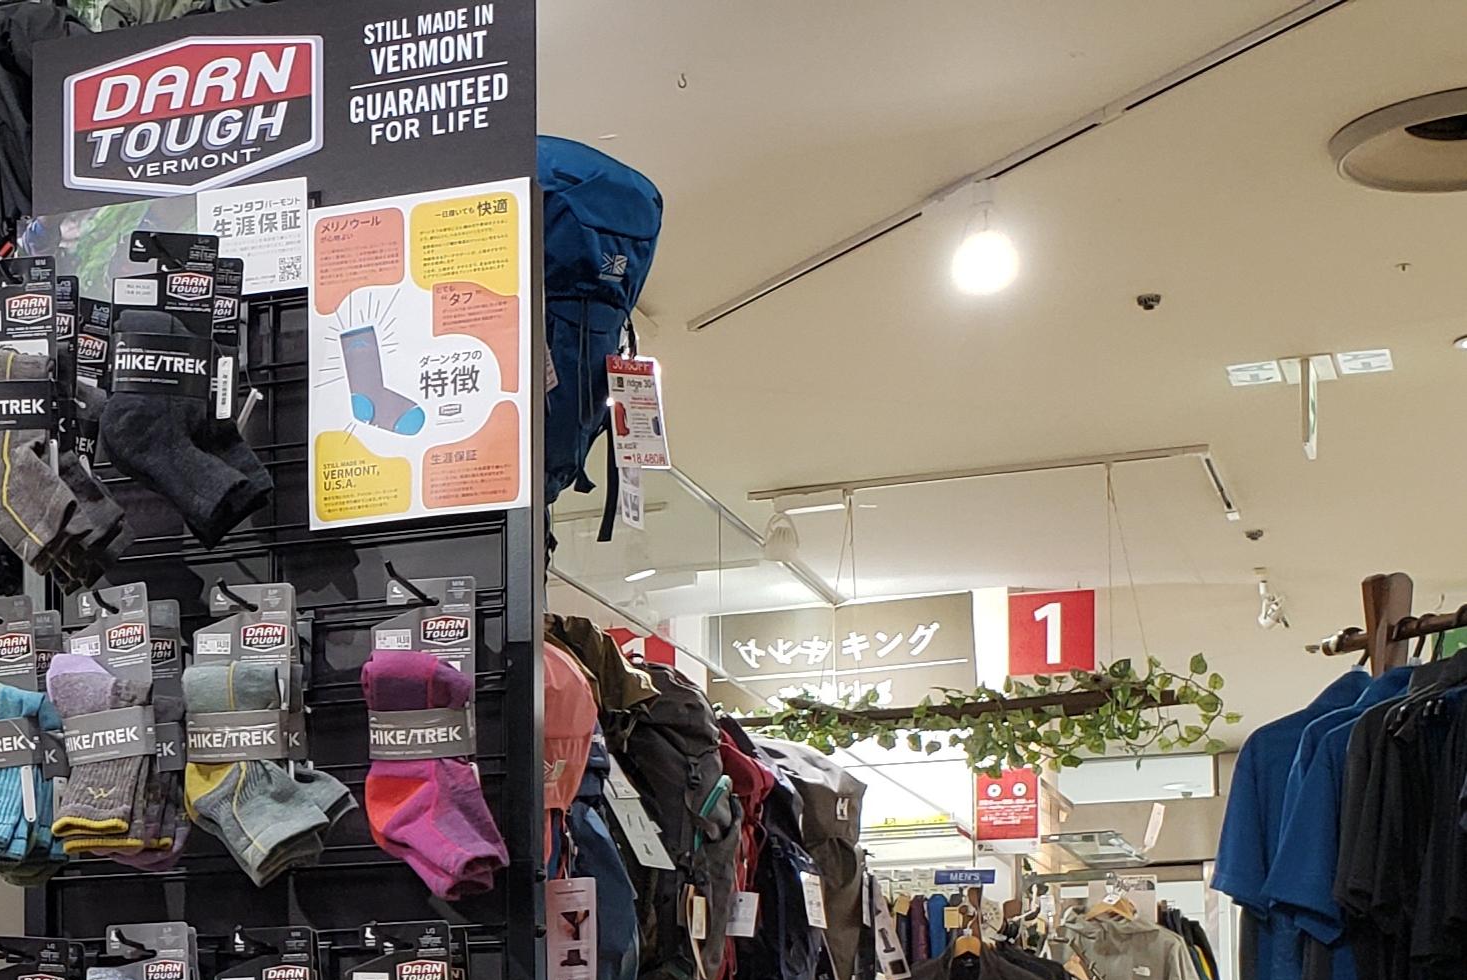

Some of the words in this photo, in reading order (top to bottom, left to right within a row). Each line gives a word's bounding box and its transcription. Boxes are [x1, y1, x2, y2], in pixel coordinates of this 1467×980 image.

[363, 20, 412, 45] STILL
[416, 10, 468, 35] MADE
[474, 4, 495, 26] IN
[370, 31, 487, 76] VERMONT
[92, 46, 298, 123] DARN
[349, 72, 509, 124] GUARANTEED
[87, 100, 289, 167] TOUGH
[370, 120, 420, 145] FOR
[431, 106, 490, 136] LIFE
[126, 147, 257, 179] VERMONT
[477, 198, 509, 217] 快適
[213, 208, 302, 239] 生涯保証
[320, 215, 382, 235] メリノウール
[170, 284, 208, 296] TOUGH
[171, 276, 210, 288] DARN
[9, 297, 50, 310] DARN
[9, 306, 47, 318] TOUGH
[114, 353, 208, 377] HIKE/TREK
[419, 350, 483, 368] ダーンタフの
[419, 364, 481, 400] 特徴
[430, 449, 478, 466] 生涯保証
[323, 464, 380, 481] VERMONT,
[323, 478, 357, 492] U.S.A.
[111, 625, 142, 639] DARN
[246, 626, 284, 637] DARN
[425, 618, 466, 632] DARN
[1033, 602, 1063, 665] 1
[110, 634, 142, 646] TOUGH
[245, 635, 282, 645] TOUGH
[425, 628, 466, 640] TOUGH
[66, 726, 140, 751] HIKE/TREK
[189, 728, 276, 749] HIKE/TREK
[371, 725, 462, 746] HIKE/TREK
[948, 870, 981, 883] MEN'S
[148, 963, 183, 974] DARN
[148, 971, 181, 980] TOUGH
[267, 968, 305, 979] DARN
[401, 963, 443, 975] DARN
